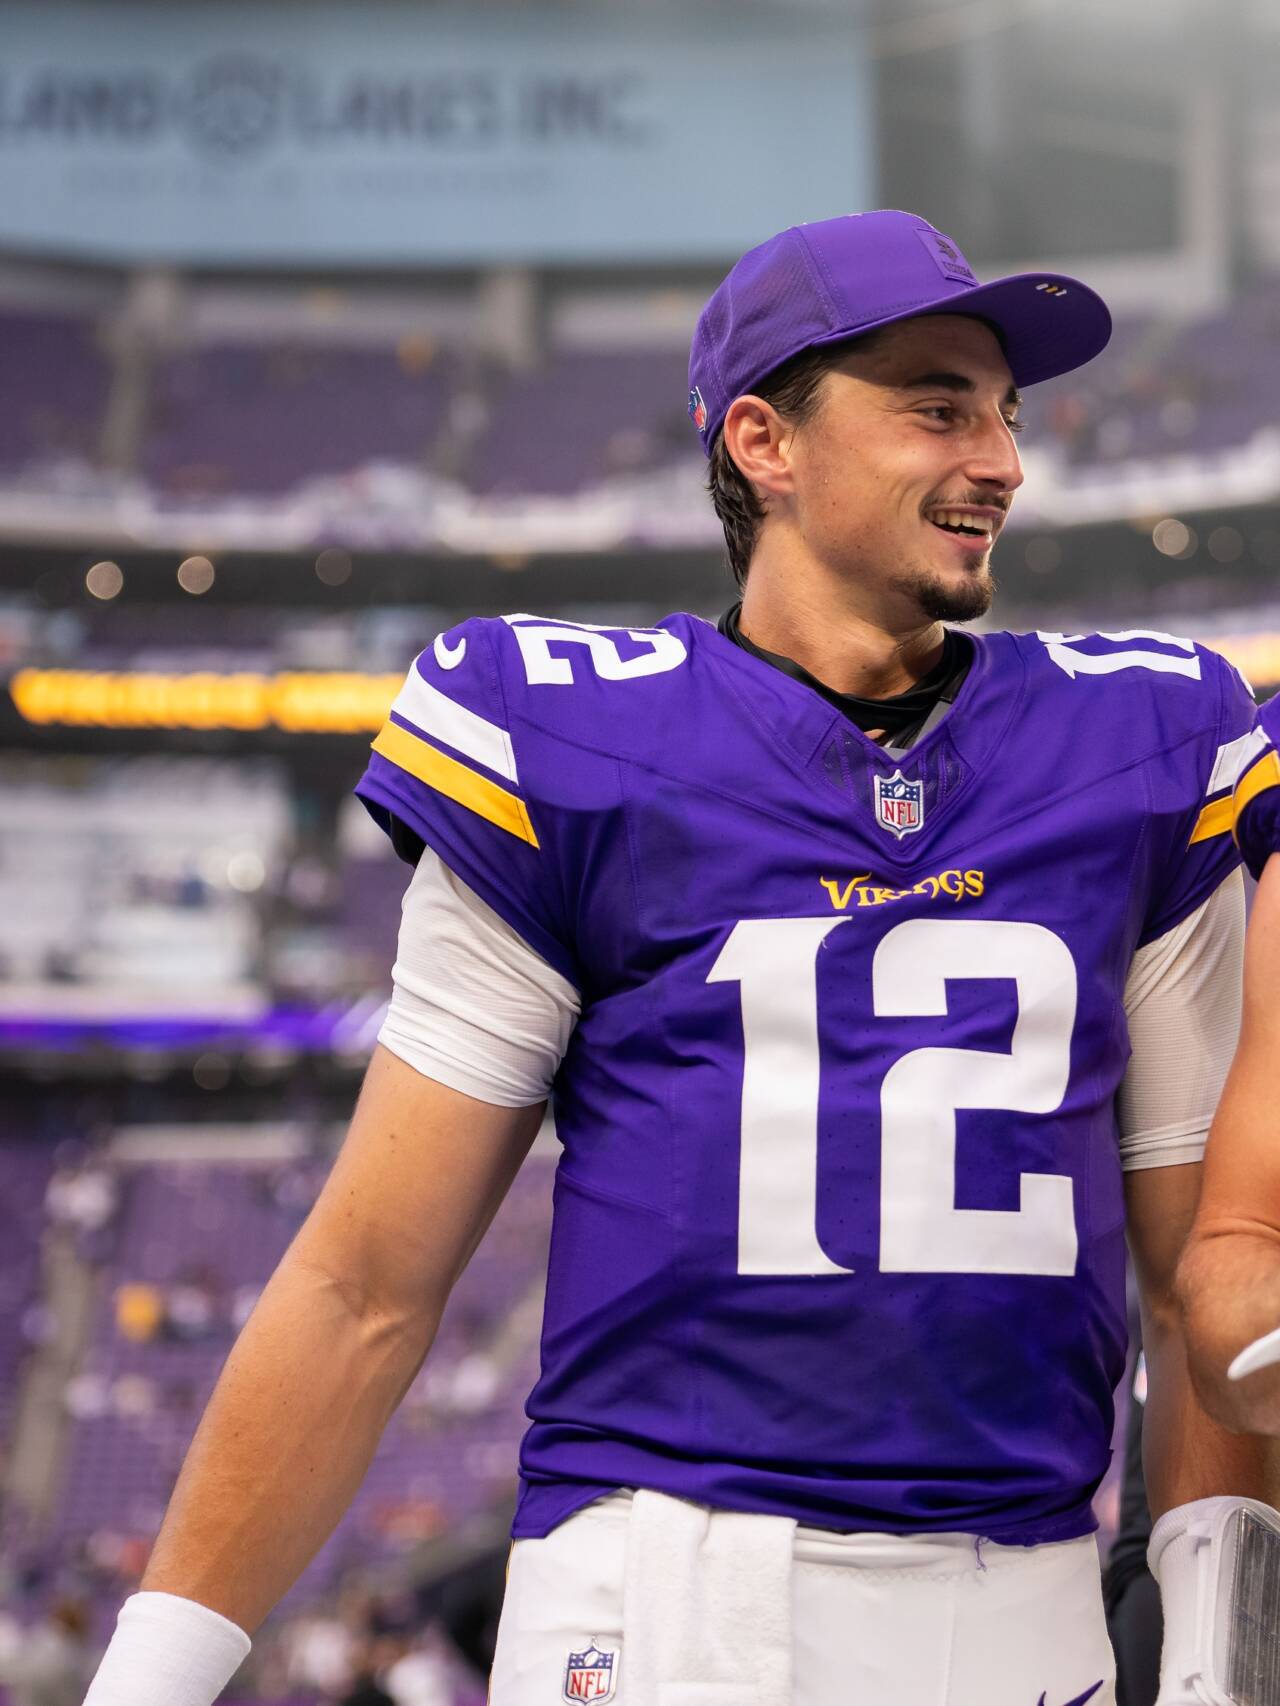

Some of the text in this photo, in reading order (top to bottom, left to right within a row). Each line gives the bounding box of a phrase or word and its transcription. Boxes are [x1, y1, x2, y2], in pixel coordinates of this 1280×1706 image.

[883, 800, 916, 826] NFL
[819, 871, 985, 911] VIKNGS
[705, 915, 1079, 1278] 12
[569, 1671, 606, 1699] NFL
